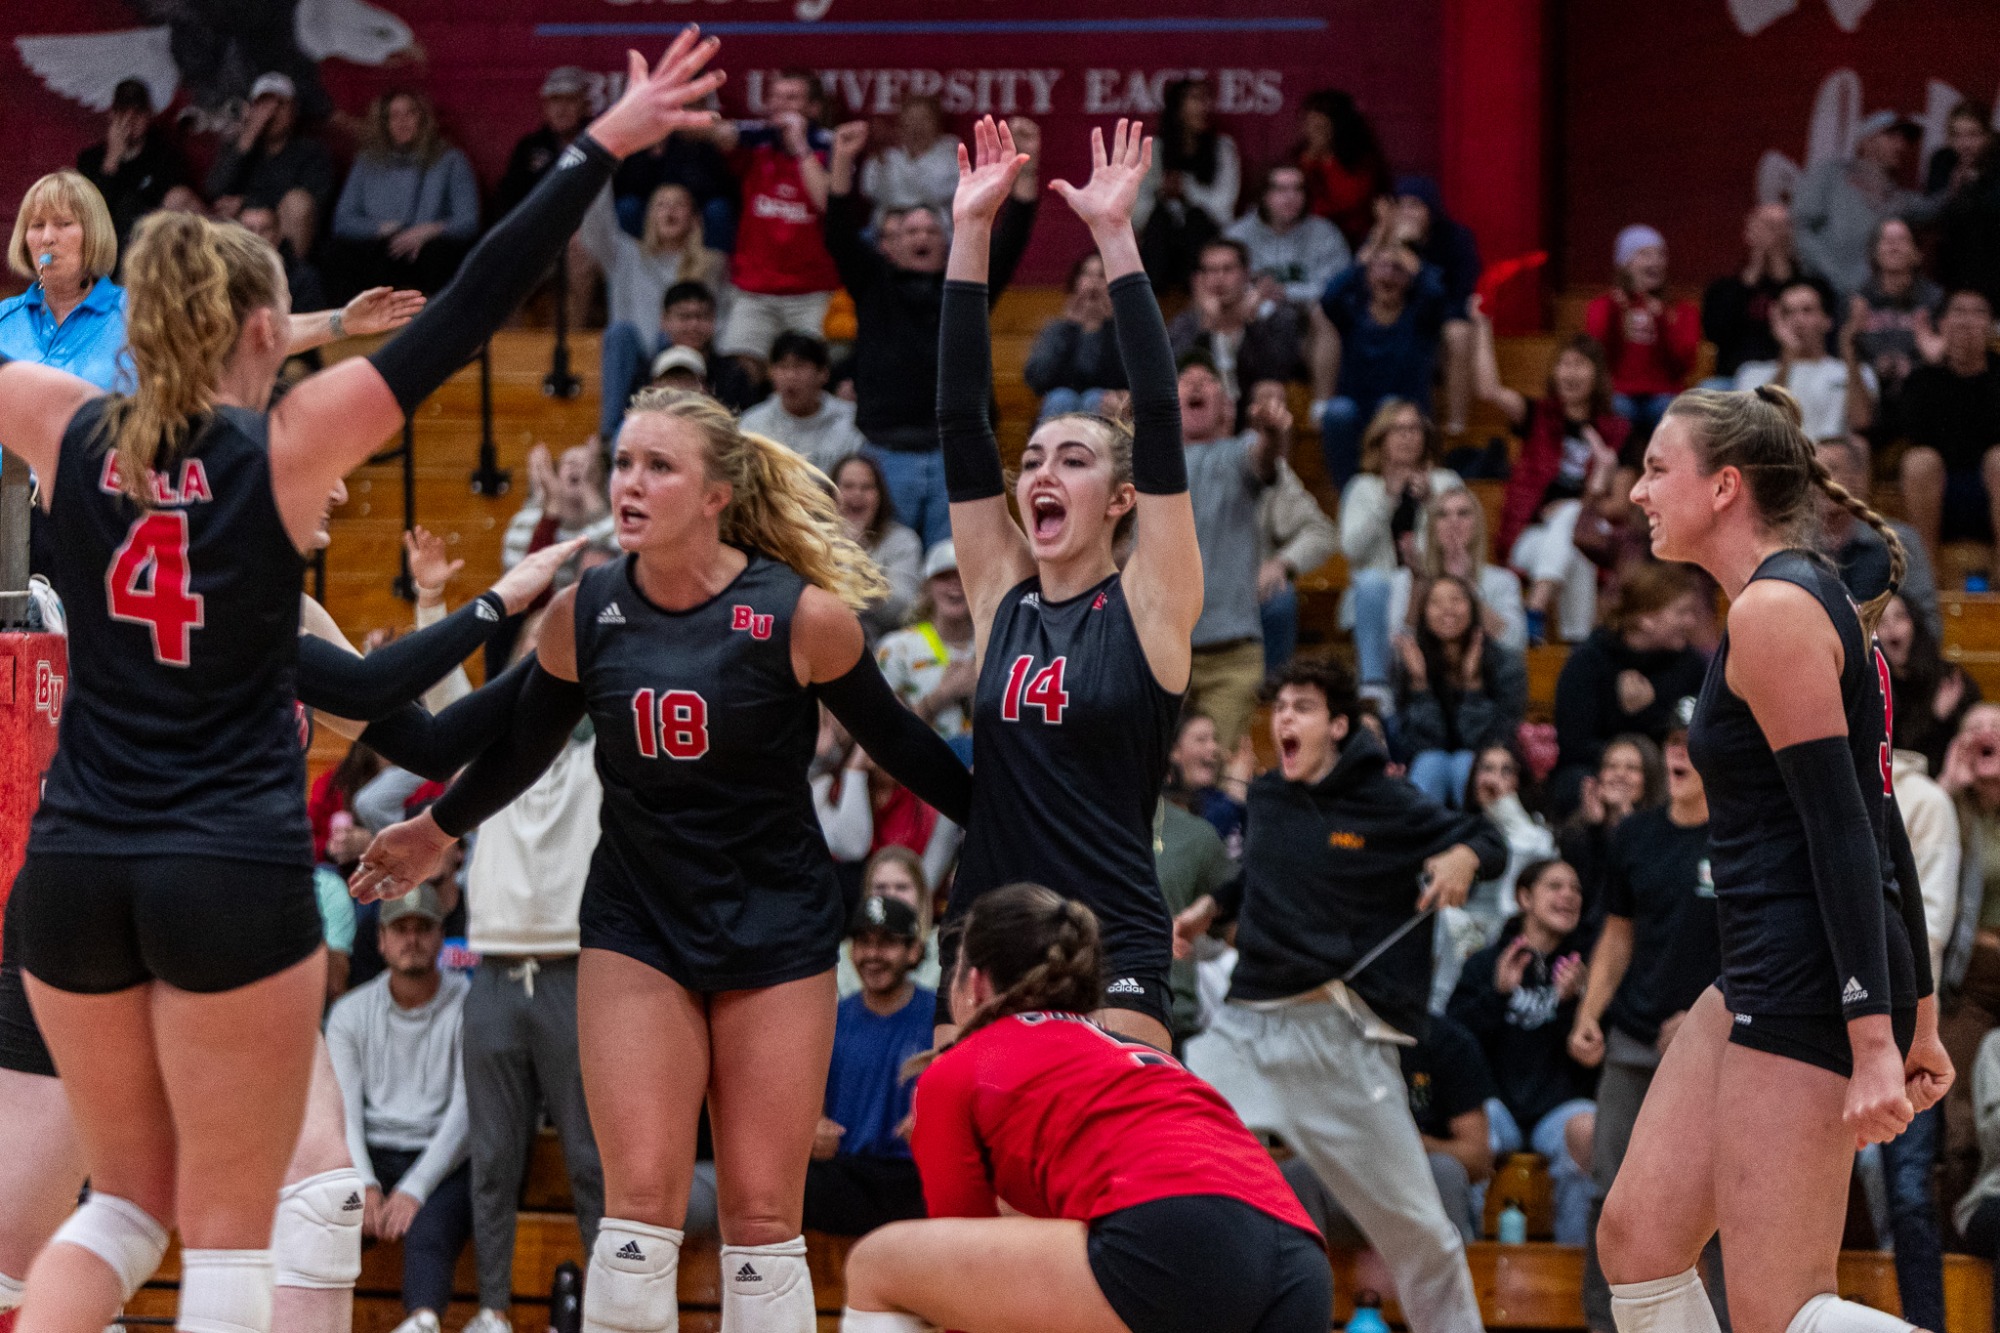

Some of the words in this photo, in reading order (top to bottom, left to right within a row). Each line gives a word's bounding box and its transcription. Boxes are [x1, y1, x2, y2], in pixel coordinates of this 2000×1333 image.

[745, 68, 1063, 114] UIVERSITY
[98, 447, 213, 506] BLA
[104, 509, 205, 668] 4
[732, 605, 774, 640] BU
[36, 660, 64, 724] BU
[1002, 654, 1069, 724] 14
[632, 687, 709, 760] 18
[1107, 984, 1145, 994] adidas
[616, 1252, 646, 1261] adidas
[735, 1274, 762, 1282] adidas
